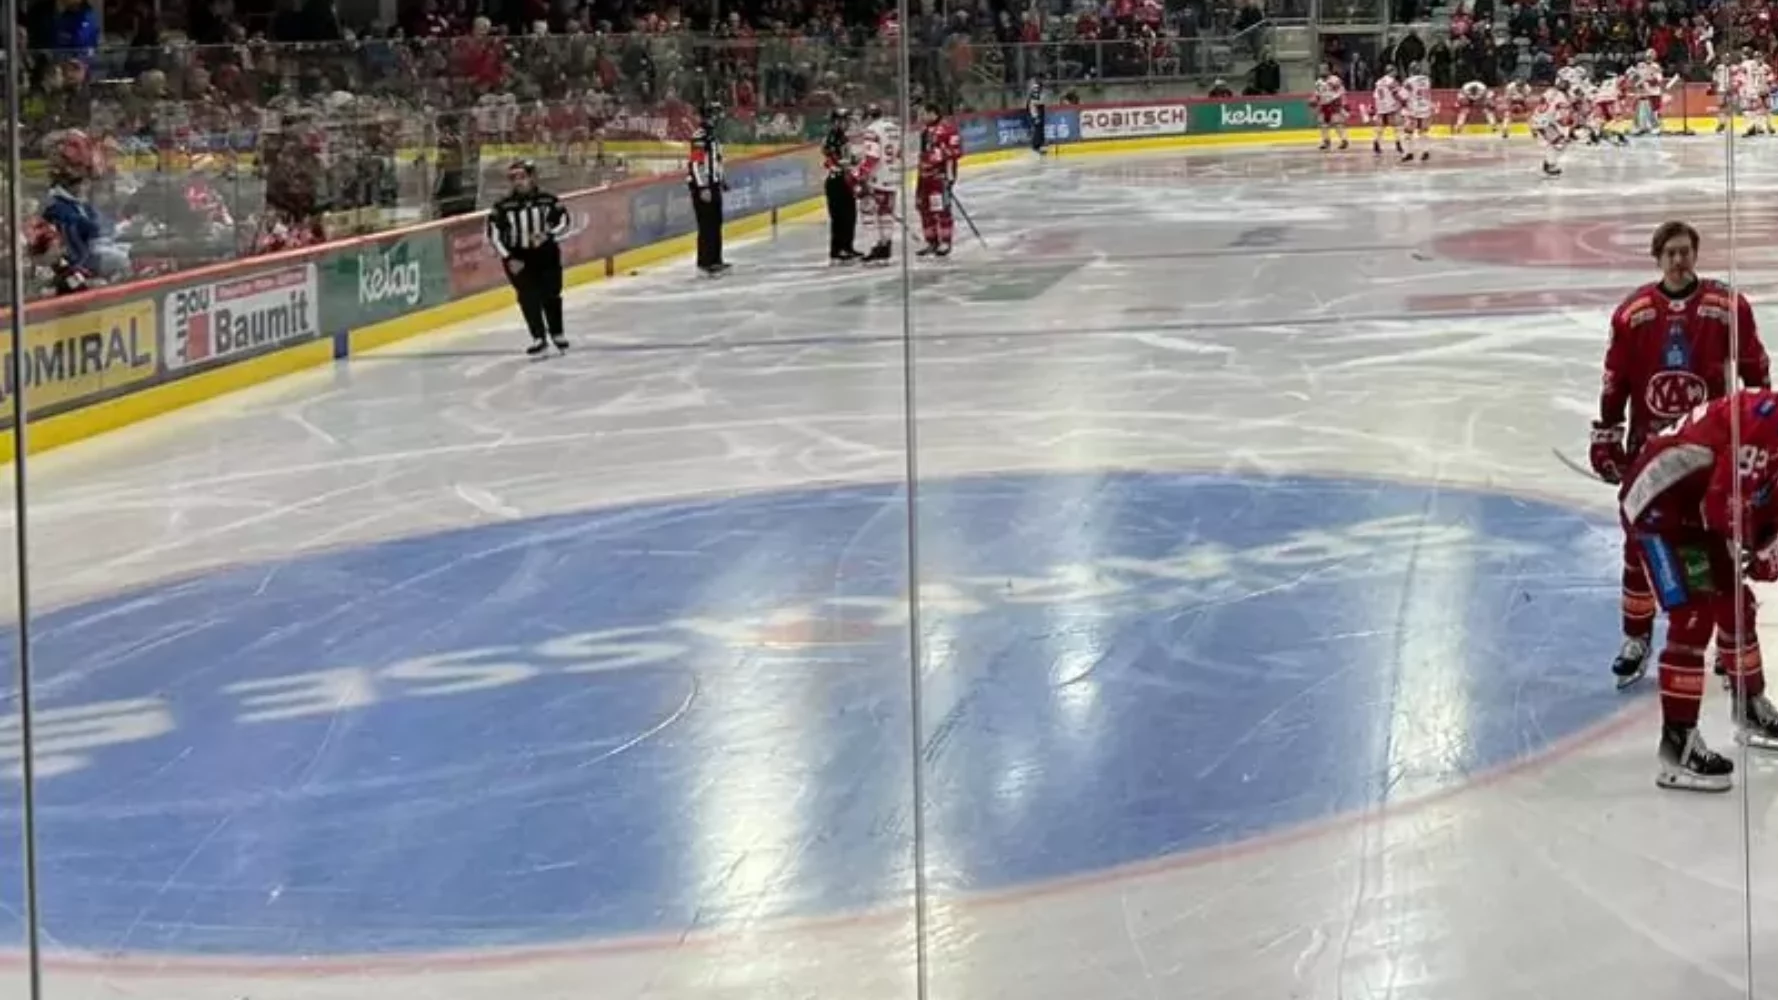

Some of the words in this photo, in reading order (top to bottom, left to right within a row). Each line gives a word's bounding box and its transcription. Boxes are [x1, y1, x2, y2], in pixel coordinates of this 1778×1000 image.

[1081, 109, 1185, 128] ROBITSCH
[1221, 104, 1283, 128] kelag
[358, 254, 421, 303] kelag
[214, 290, 309, 352] Baumit
[0, 316, 150, 397] DMIRAL
